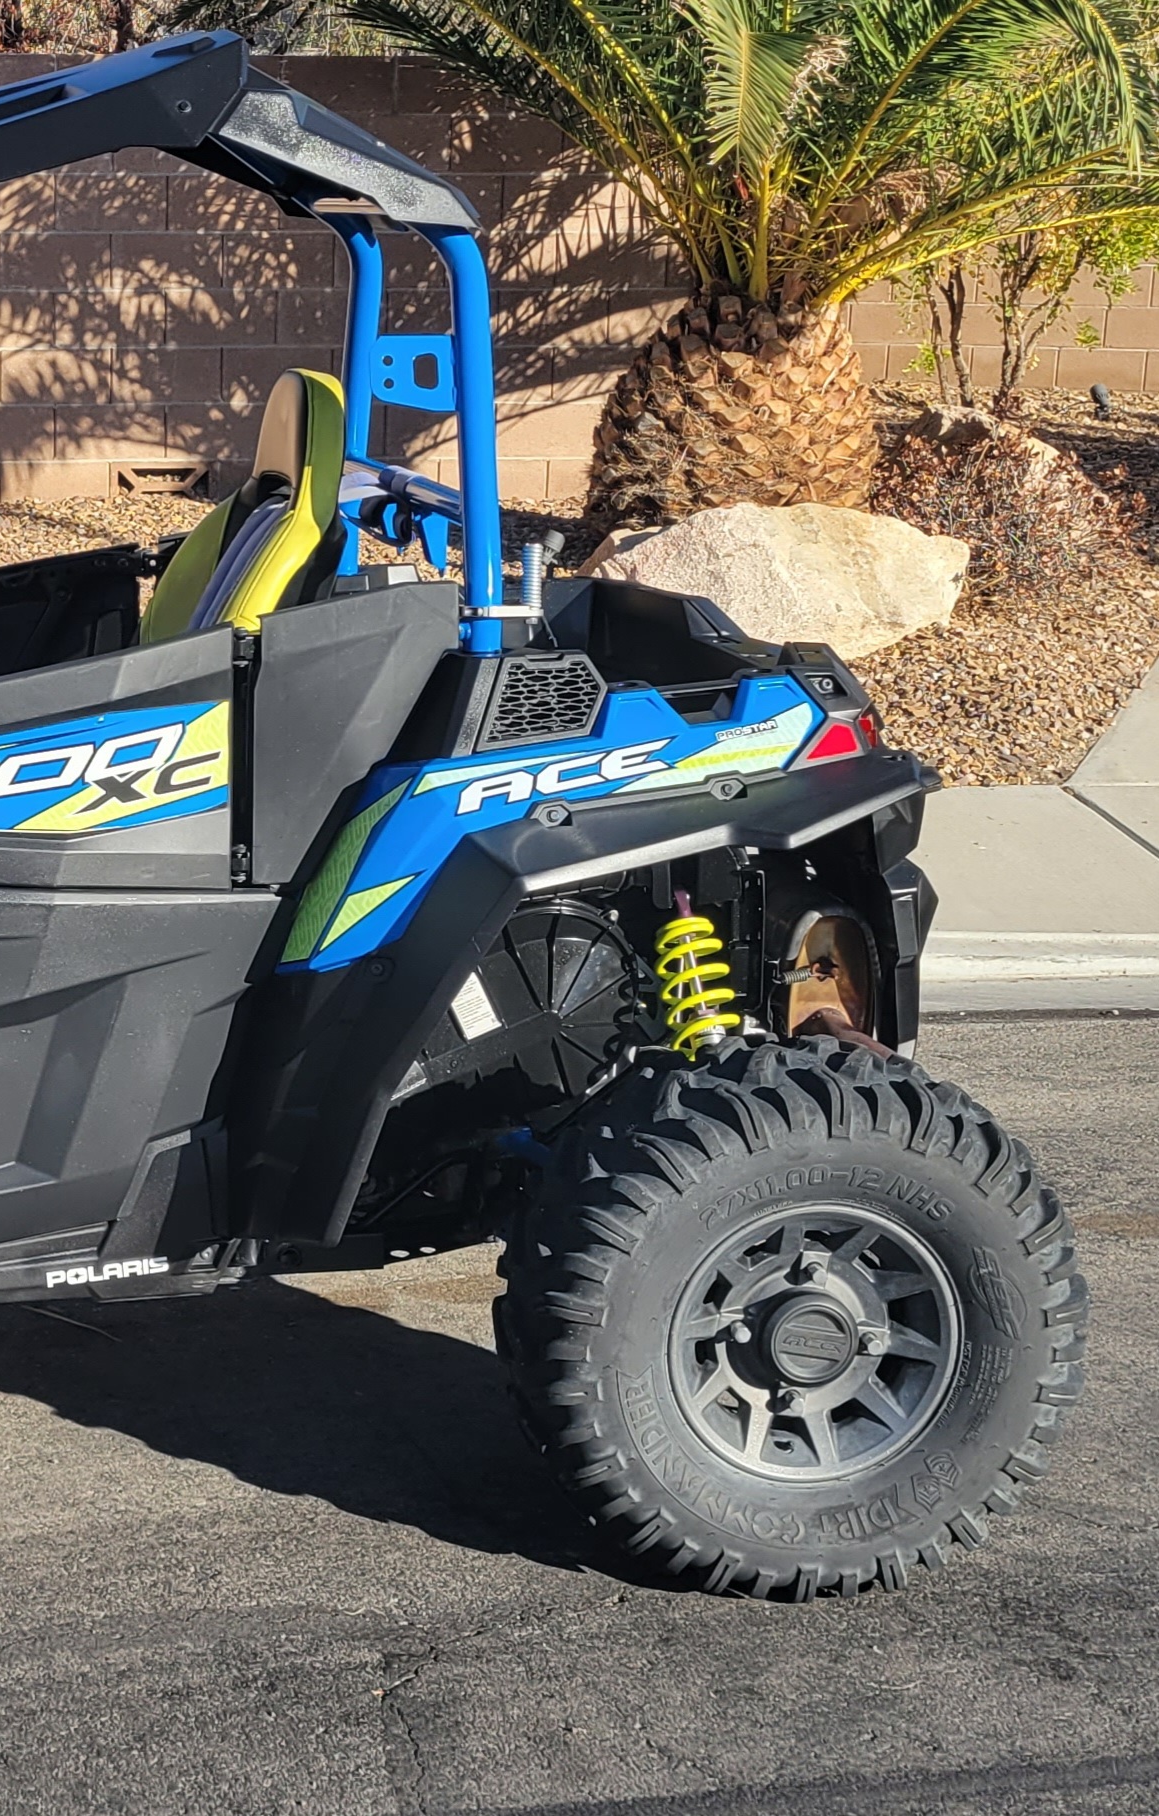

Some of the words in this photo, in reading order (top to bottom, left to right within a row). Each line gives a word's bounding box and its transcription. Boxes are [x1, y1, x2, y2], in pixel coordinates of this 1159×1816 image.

[715, 719, 778, 741] PROSTAR
[73, 752, 222, 816] XC
[456, 738, 673, 816] ACE
[886, 1174, 956, 1222] NHS
[45, 1256, 170, 1288] POLARIS
[625, 1377, 806, 1545] COMMANDER
[819, 1492, 901, 1545] DIRT
